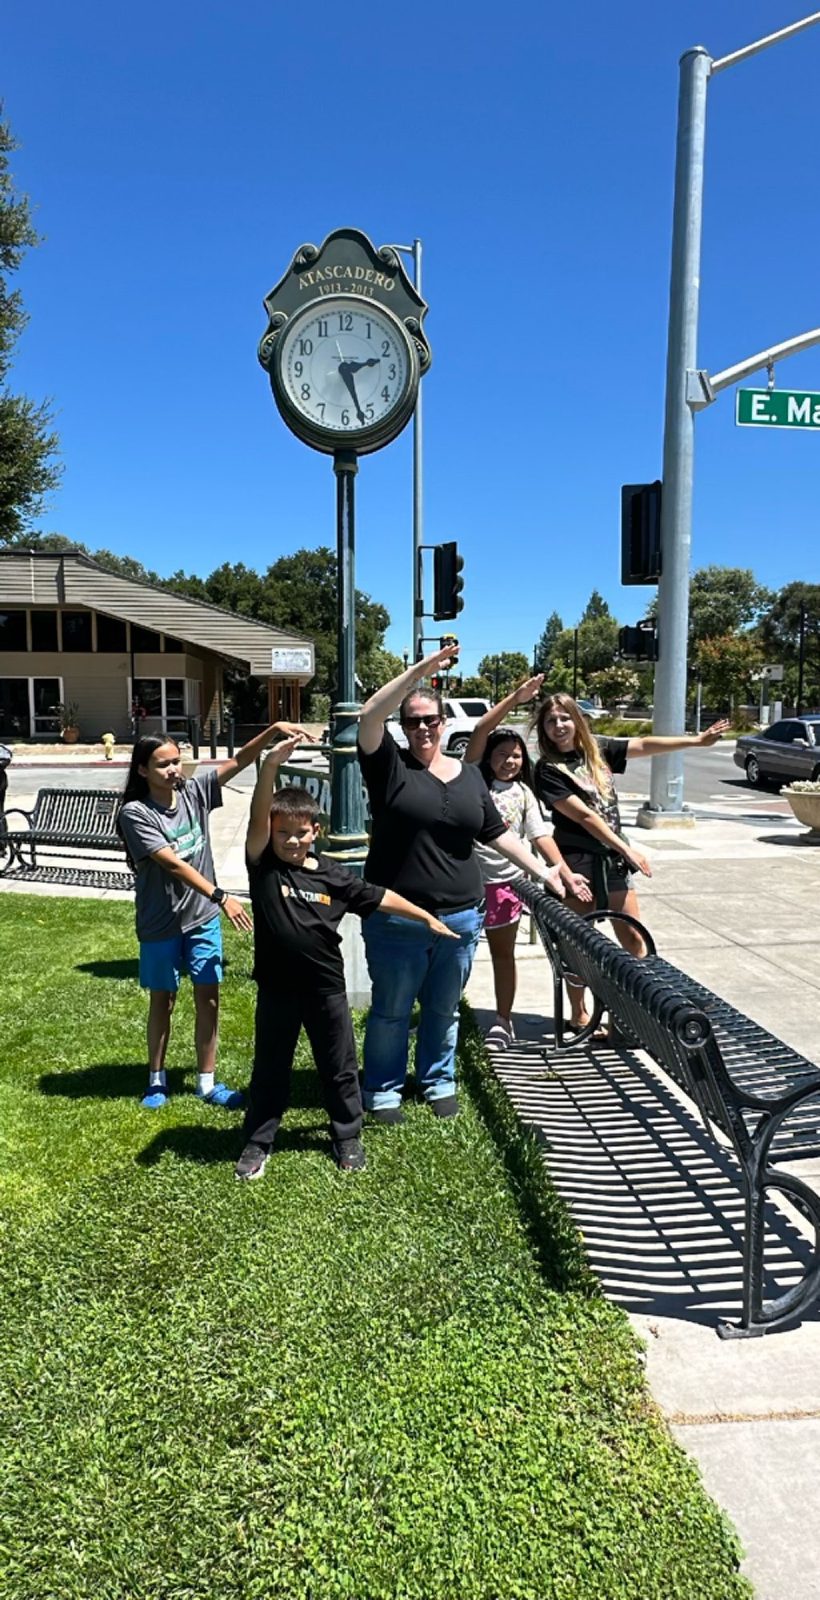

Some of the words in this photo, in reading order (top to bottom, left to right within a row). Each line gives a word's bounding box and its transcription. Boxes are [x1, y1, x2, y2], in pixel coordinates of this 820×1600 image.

[299, 265, 396, 291] ATASCADERO
[318, 283, 341, 296] 1913
[351, 283, 374, 297] 2013
[318, 321, 328, 337] 11
[339, 314, 353, 331] 12
[366, 323, 371, 339] 1
[300, 339, 313, 356] 10
[382, 341, 390, 357] 2
[294, 361, 303, 378] 9
[388, 364, 396, 380] 3
[301, 383, 310, 400] 8
[381, 385, 390, 402] 4
[316, 403, 326, 419] 7
[365, 403, 374, 420] 5
[752, 394, 777, 422] E.
[341, 409, 349, 426] 6
